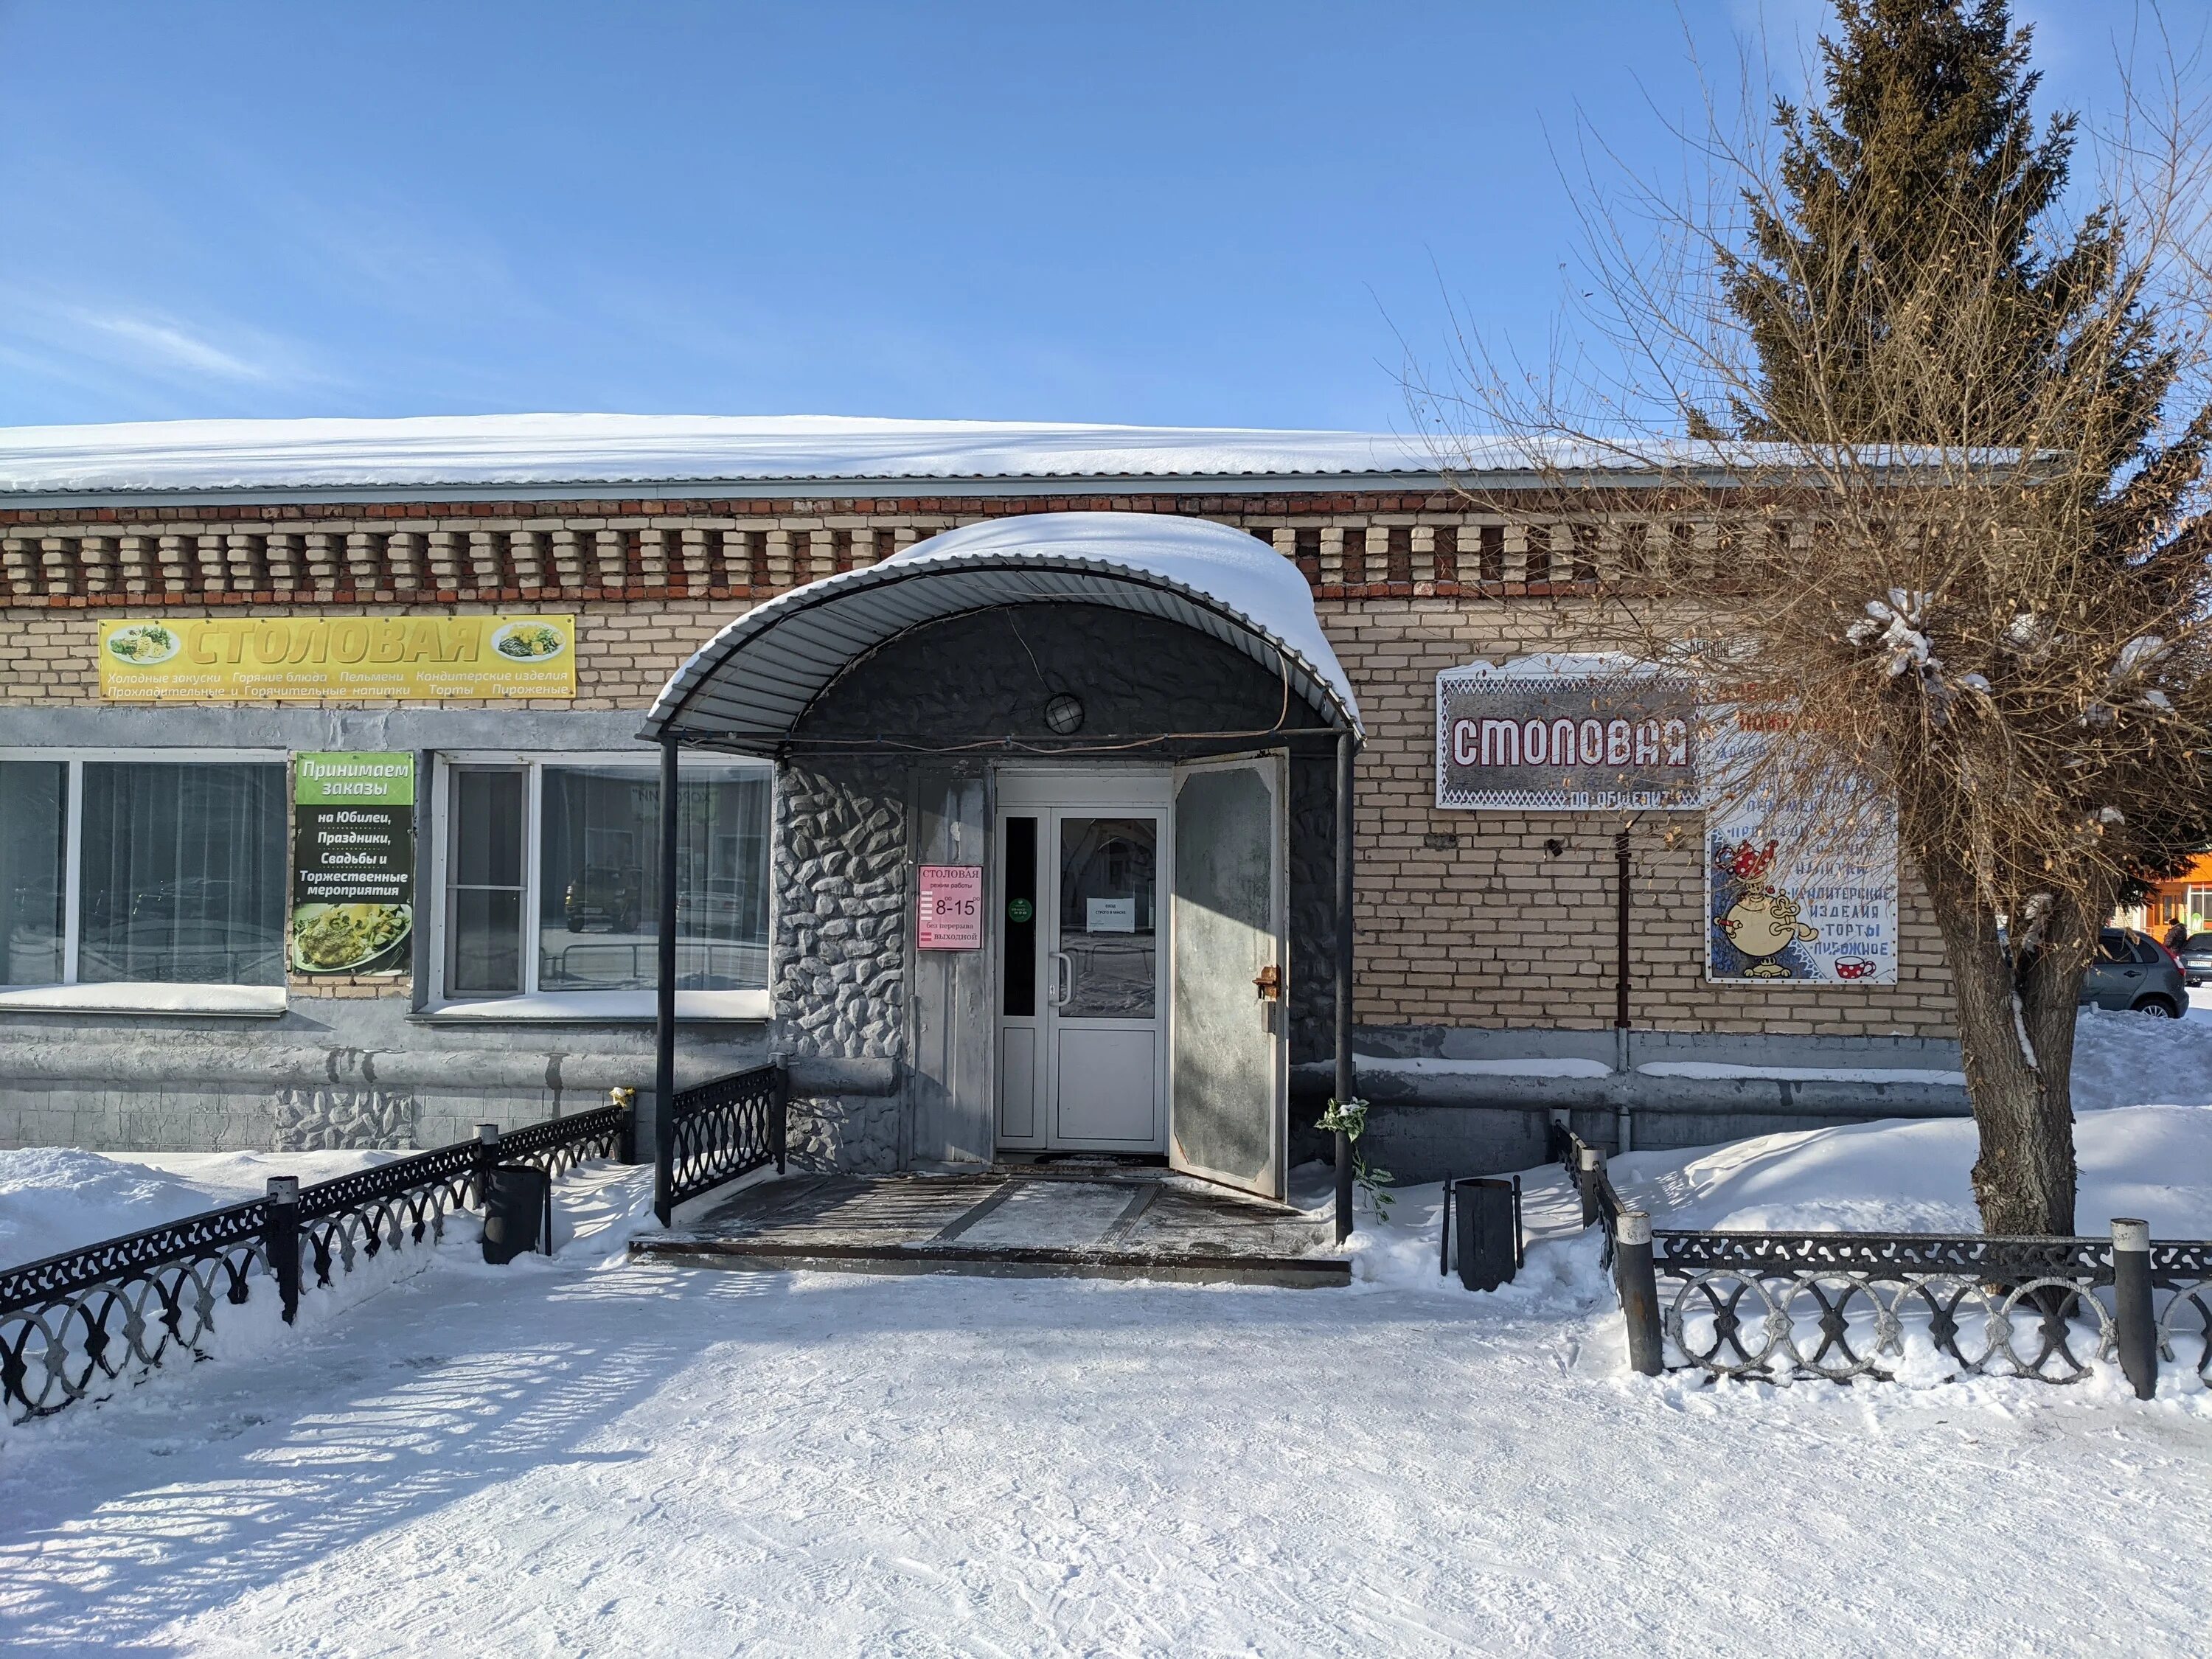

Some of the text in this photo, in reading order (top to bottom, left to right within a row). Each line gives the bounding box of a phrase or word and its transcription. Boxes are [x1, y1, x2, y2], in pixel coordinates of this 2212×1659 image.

[187, 619, 484, 664] СТОЛОВАЯ
[108, 670, 568, 686] Холодные закуски Горячие блюда Пельмени Кондитерские изделия
[108, 686, 225, 699] Прохладительные
[245, 685, 347, 697] Горячительные
[352, 686, 411, 695] напитки
[429, 684, 473, 695] Торты
[493, 684, 569, 695] Пироженые
[1453, 717, 1688, 767] СТОЛОВАЯ
[302, 760, 408, 781] Принимаем
[321, 782, 389, 796] заказы
[318, 813, 333, 823] на
[317, 832, 391, 846] Праздники,
[321, 851, 387, 865] Свадьбы и
[299, 870, 408, 883] Торжественные
[922, 869, 979, 878] СТОЛОВАЯ
[307, 885, 399, 897] мероприятия
[1810, 905, 1879, 919] ИЗДЕЛИЯ
[1826, 923, 1880, 937] ТОРТЫ
